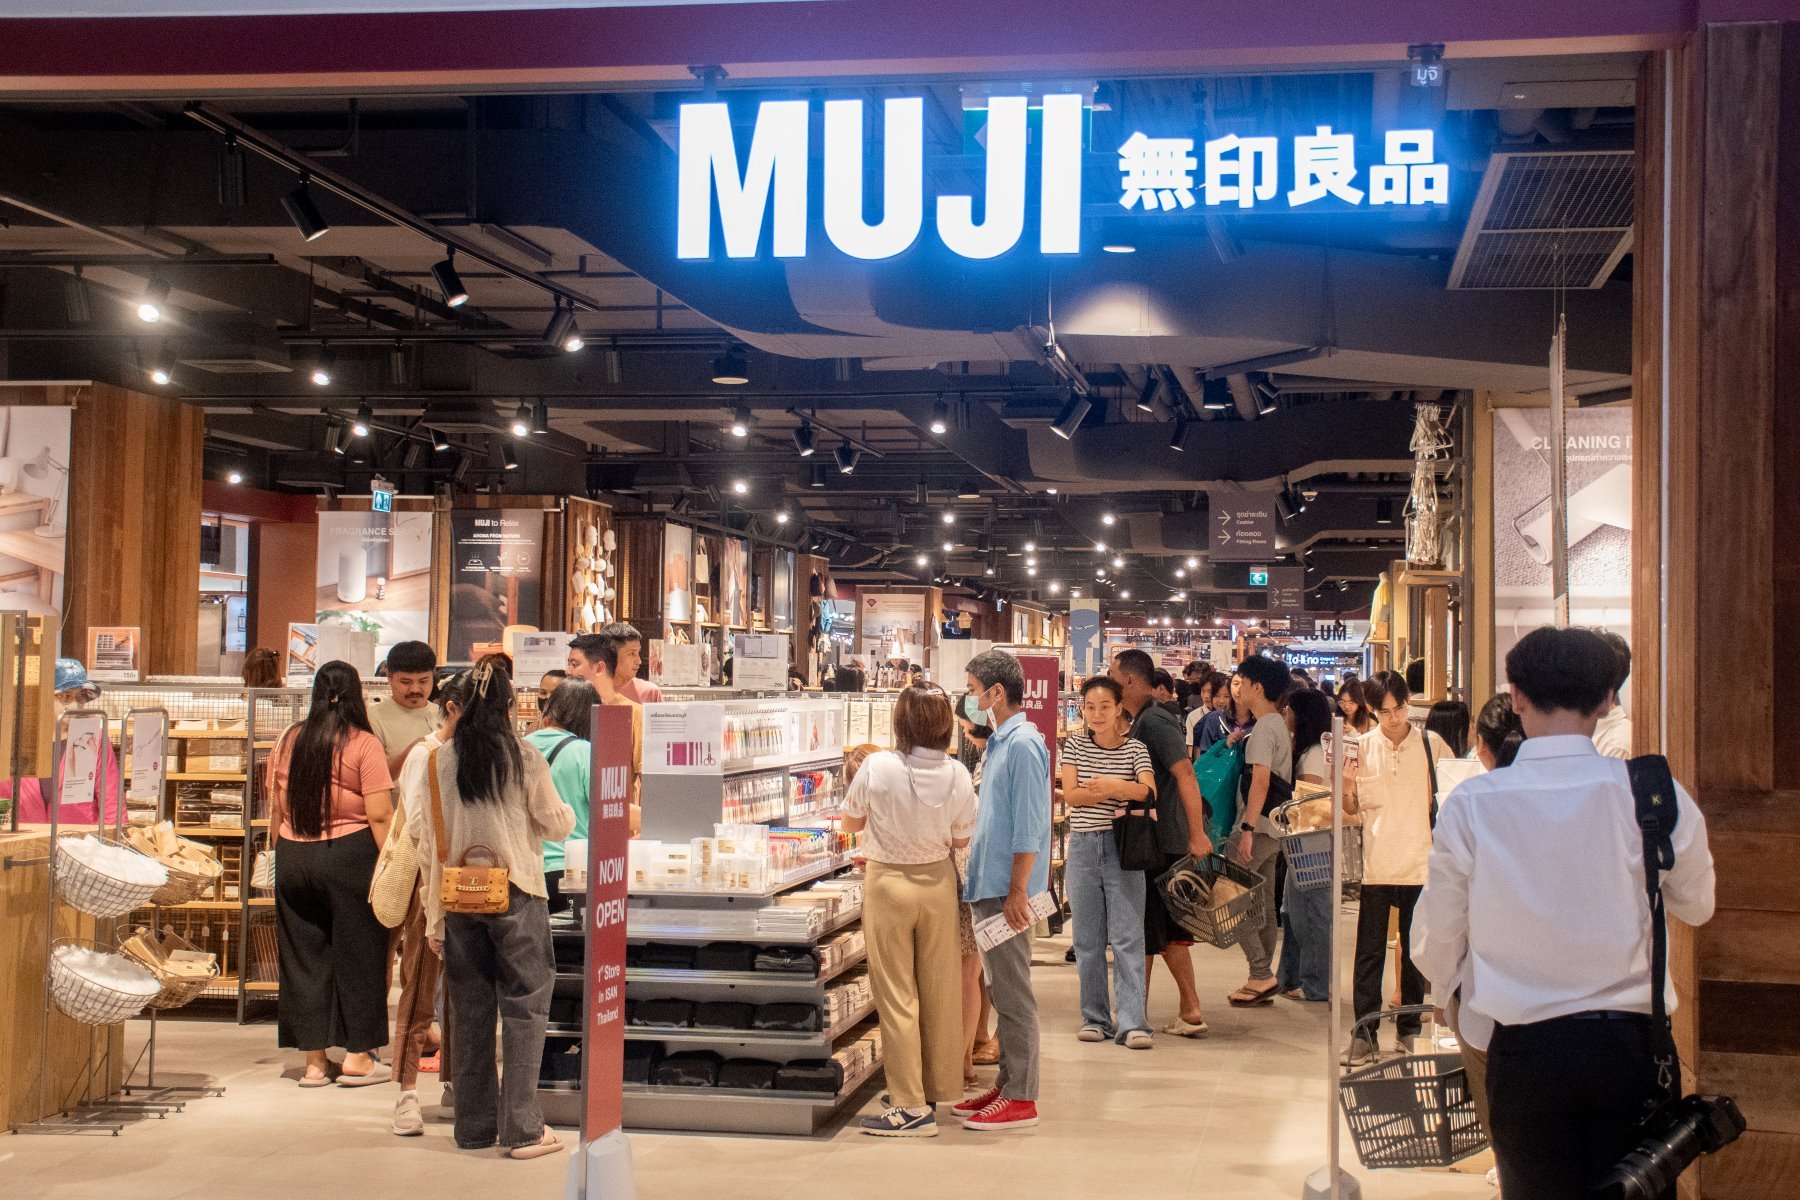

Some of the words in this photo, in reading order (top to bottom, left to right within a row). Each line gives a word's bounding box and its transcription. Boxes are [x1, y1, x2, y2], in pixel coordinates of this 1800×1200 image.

[1417, 66, 1438, 85] มูจิ
[677, 94, 1082, 260] MUJI
[1117, 126, 1449, 211] 無印良品
[1532, 435, 1620, 450] CLANING
[329, 527, 388, 536] FRAGRANCE
[474, 519, 491, 527] MUJI
[491, 519, 499, 527] to
[500, 519, 519, 527] Relax
[1022, 679, 1048, 699] UJI
[1020, 699, 1043, 710] 良品
[601, 765, 627, 800] MUJI
[599, 856, 625, 886] NOW
[596, 897, 625, 929] OPEN
[604, 964, 621, 980] Store
[605, 984, 618, 1002] ISAN
[597, 1005, 619, 1026] Thailand
